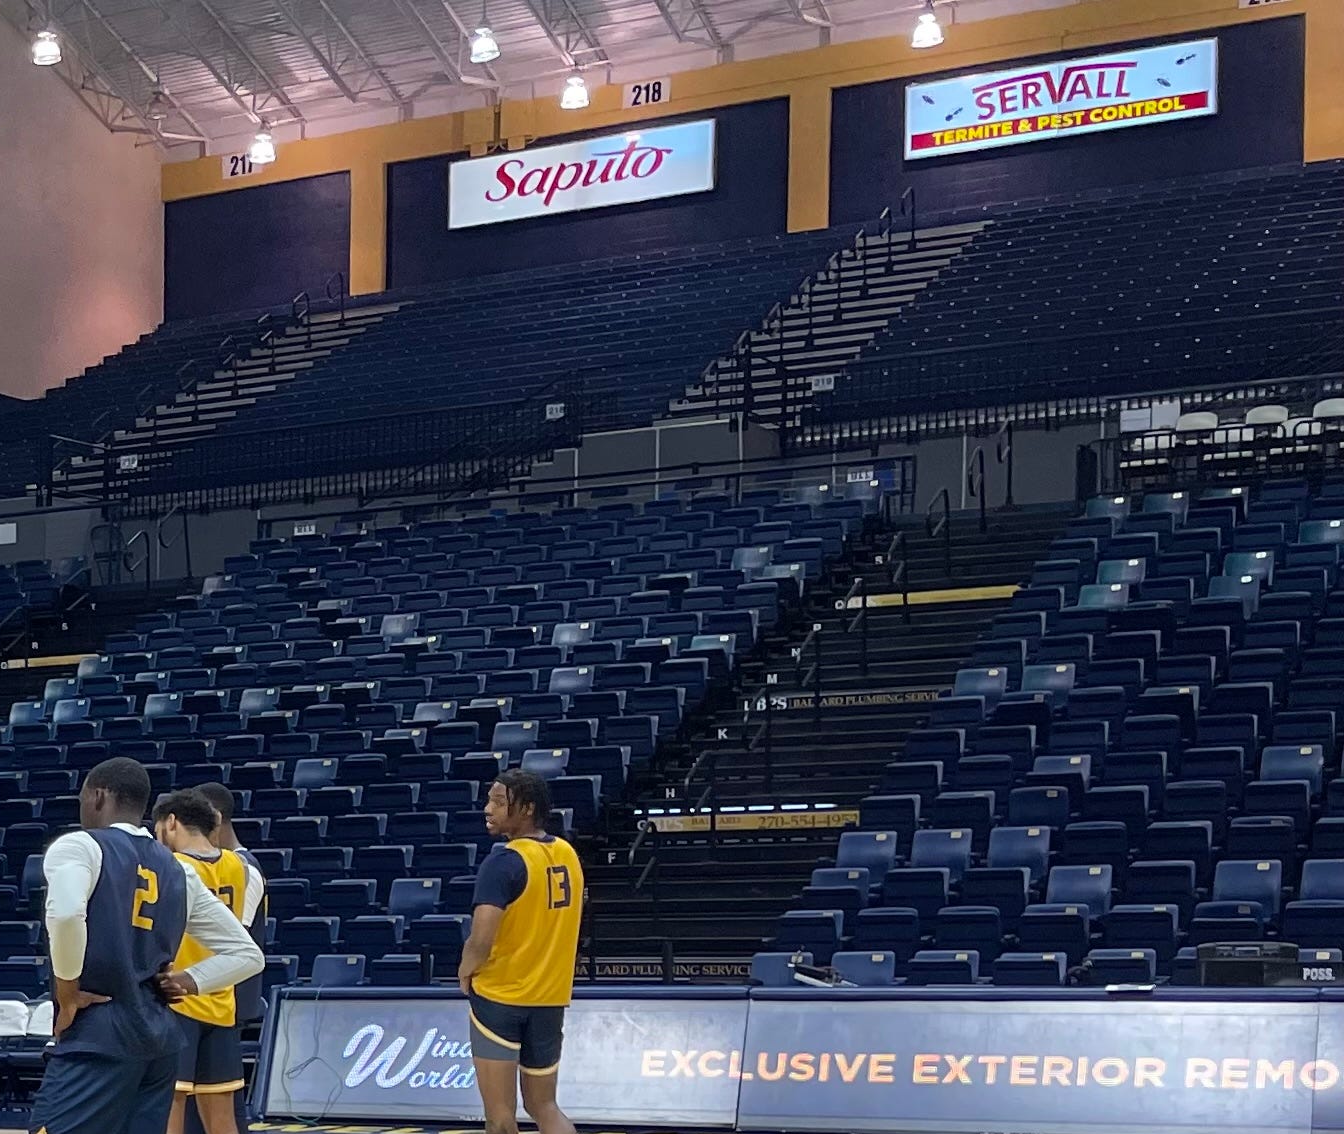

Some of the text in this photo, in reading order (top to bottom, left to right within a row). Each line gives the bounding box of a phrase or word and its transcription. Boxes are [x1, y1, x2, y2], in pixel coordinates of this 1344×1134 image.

[632, 81, 661, 106] 218
[972, 61, 1137, 120] SERVALL
[932, 97, 1186, 146] TERMITE & PEST CONTROL
[485, 140, 673, 206] Saputo
[767, 674, 778, 684] M
[717, 729, 728, 739] K
[665, 788, 675, 798] H
[608, 853, 616, 863] F
[132, 863, 159, 930] 2
[546, 865, 572, 910] 13
[1303, 967, 1335, 981] POSS.
[640, 1050, 1340, 1090] EXCLUSIVE EXTERIOR REMO
